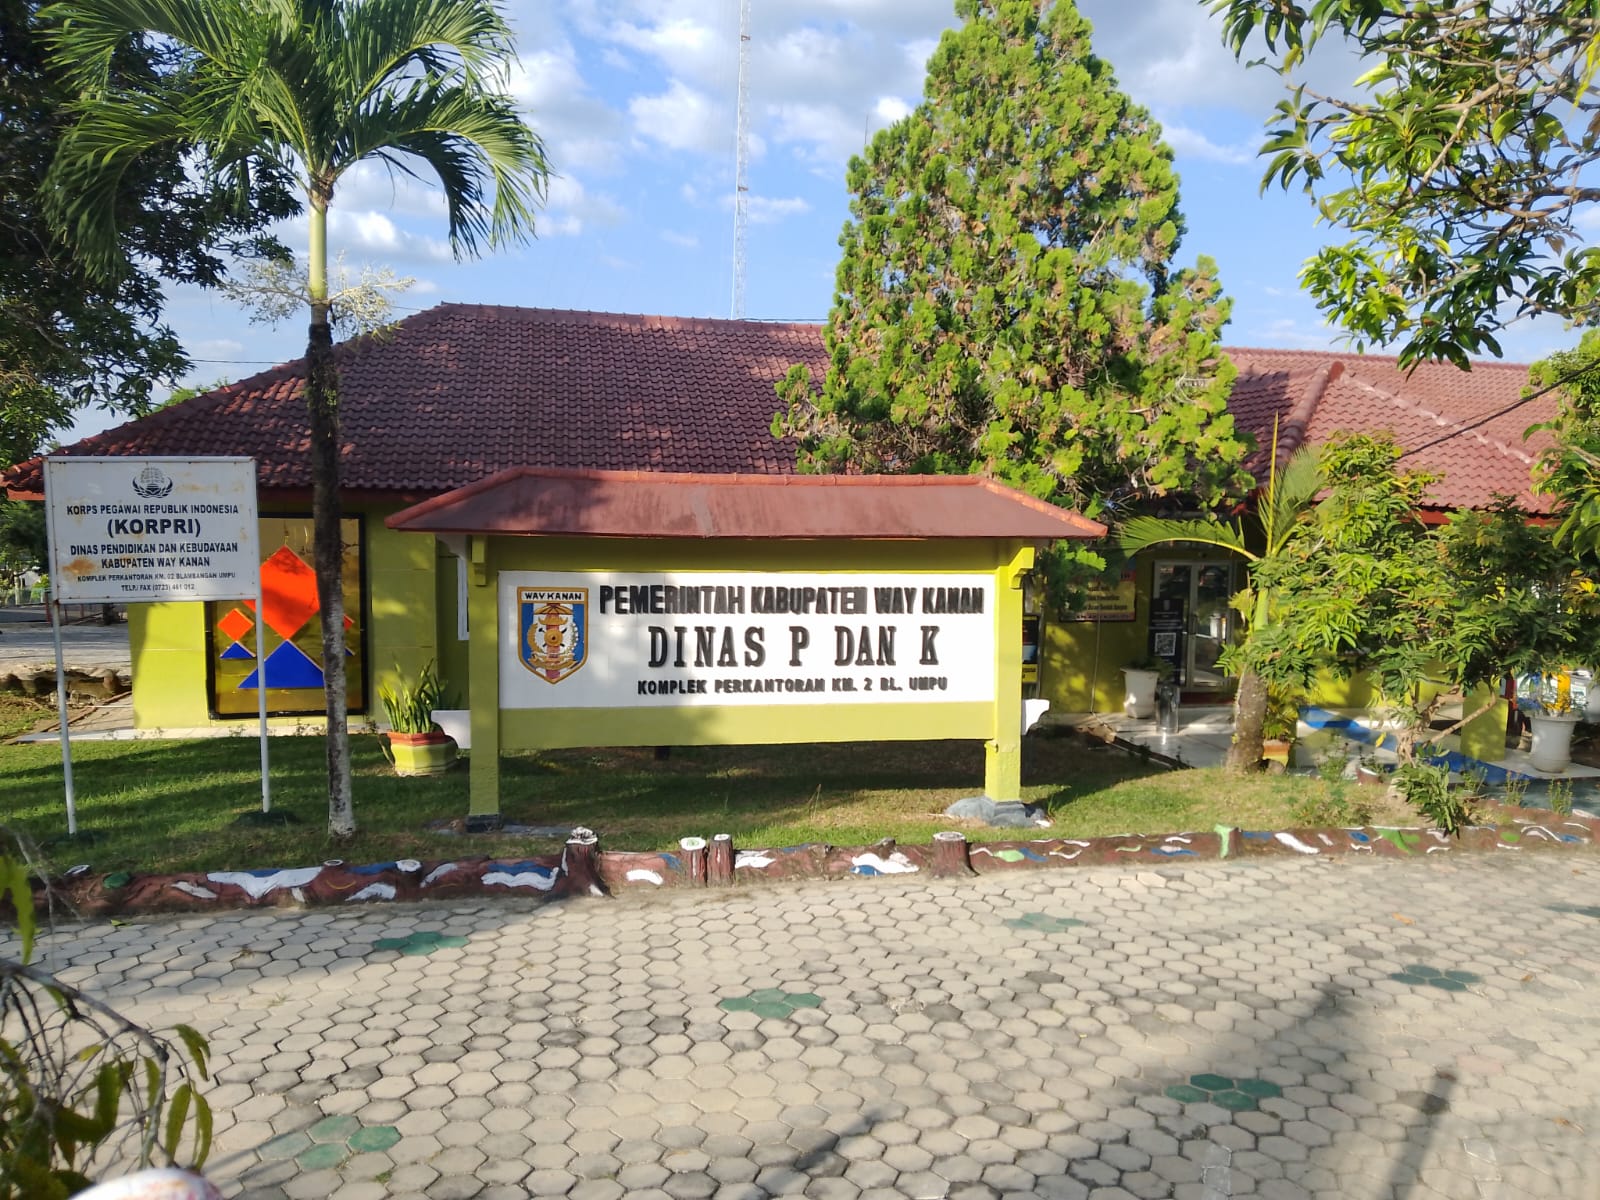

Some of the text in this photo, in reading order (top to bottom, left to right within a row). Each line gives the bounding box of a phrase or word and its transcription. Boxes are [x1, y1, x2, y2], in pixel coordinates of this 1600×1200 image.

[67, 504, 238, 515] KORPS PEGAWAI REPUBLIK INDONESIA
[108, 518, 200, 538] (KORPRI)
[70, 542, 238, 556] DINAS PENDIDIKAN DAN KEBUDAYAAN
[102, 556, 210, 568] KABUPATEN WAY KANAN
[524, 592, 582, 600] WAY KANAN
[600, 585, 984, 614] PEMERINTAH KABUPATEN WAY KANAN
[648, 626, 940, 668] DINAS P DAN K
[638, 677, 948, 695] KOMPLEK PERKANTORAN KM. 2 BL. UMPU
